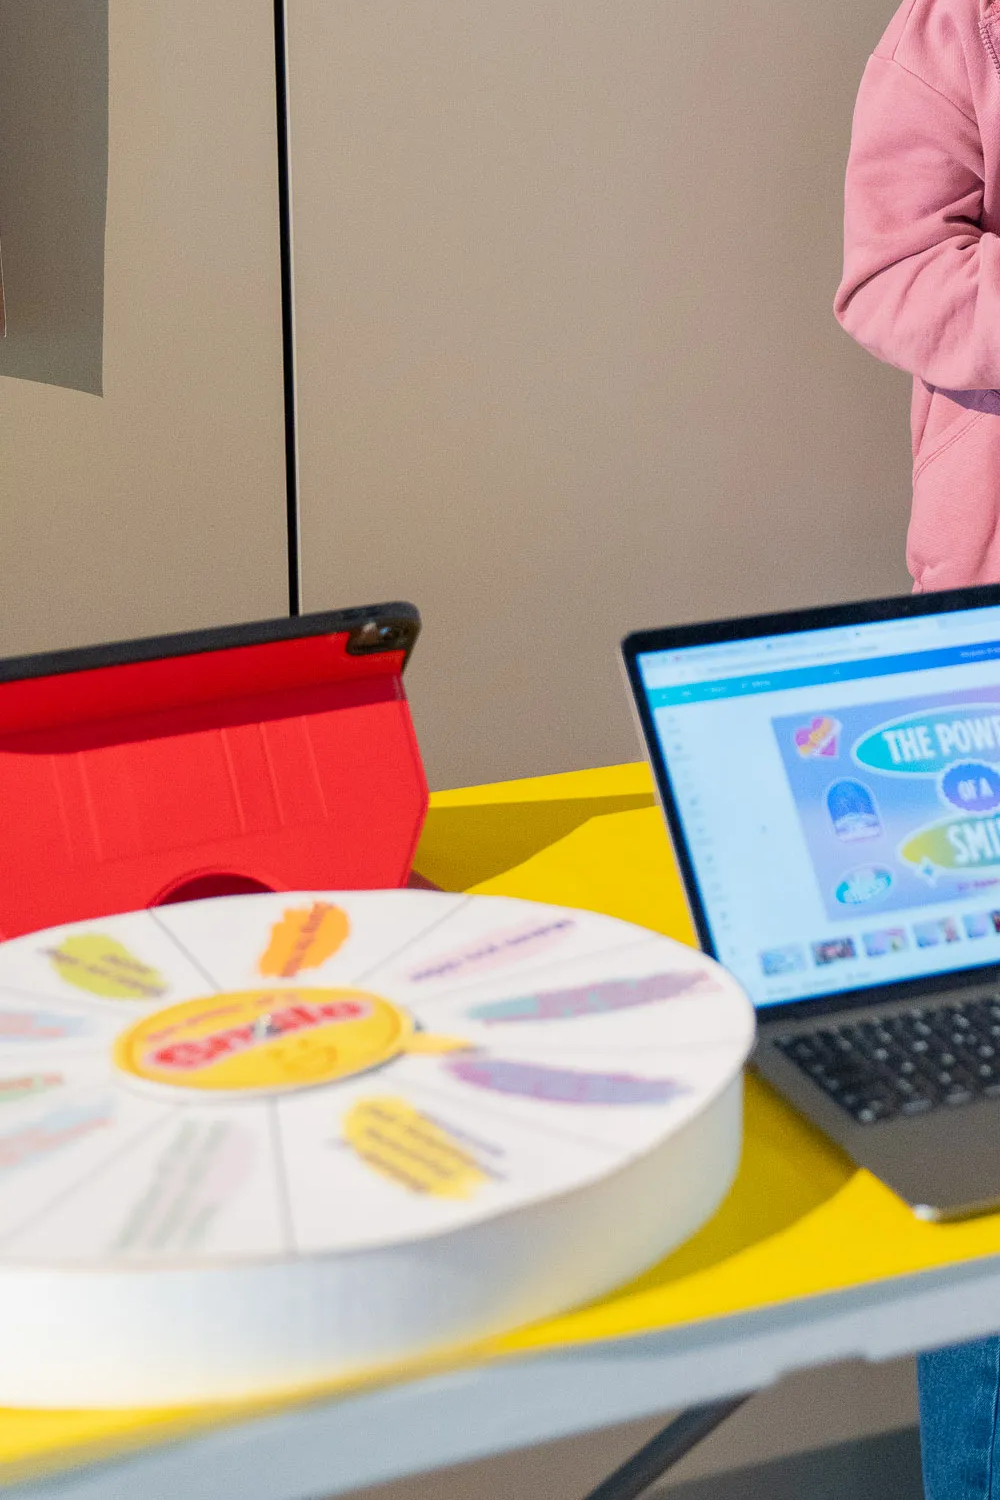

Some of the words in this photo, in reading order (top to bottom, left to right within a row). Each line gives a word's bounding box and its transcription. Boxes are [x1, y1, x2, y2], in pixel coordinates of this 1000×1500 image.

[881, 725, 936, 765] THE
[957, 779, 978, 802] OF
[979, 776, 995, 798] A
